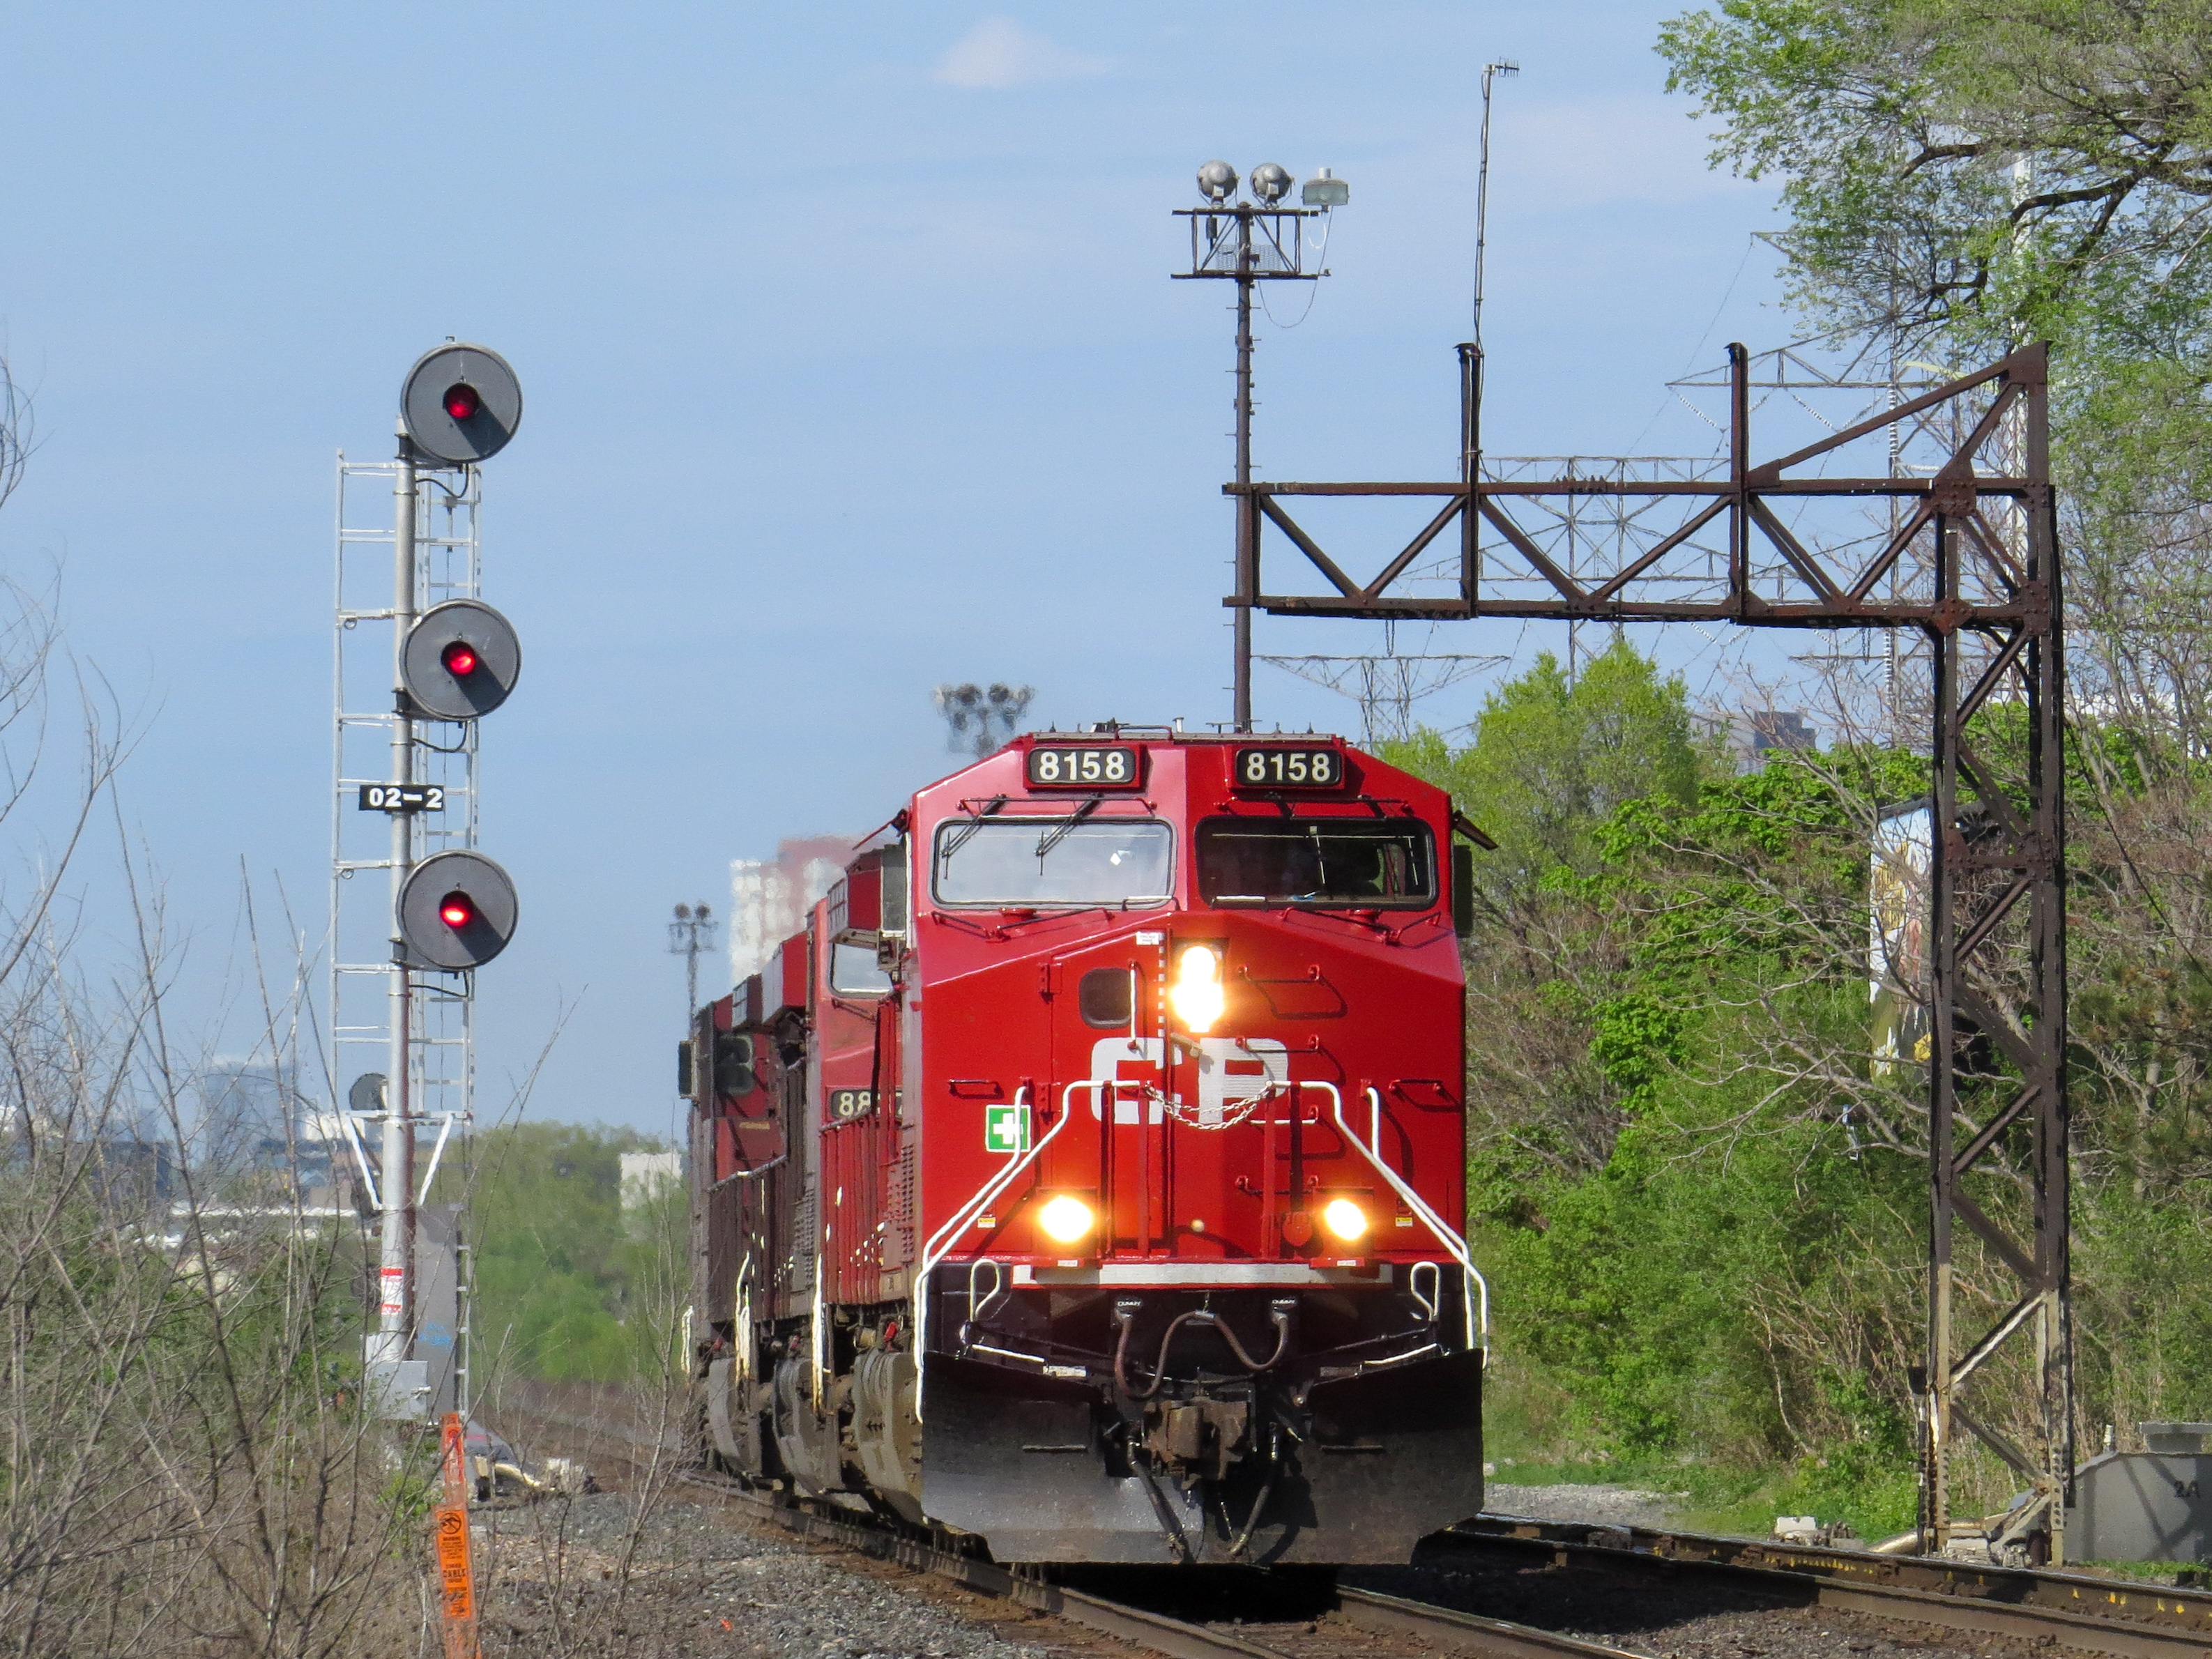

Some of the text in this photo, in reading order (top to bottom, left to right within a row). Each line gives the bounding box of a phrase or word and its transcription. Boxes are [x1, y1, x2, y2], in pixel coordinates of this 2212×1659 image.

[1039, 751, 1124, 781] 8158
[1246, 752, 1331, 781] 8158
[369, 788, 443, 808] 02-2
[1090, 1037, 1289, 1125] CP
